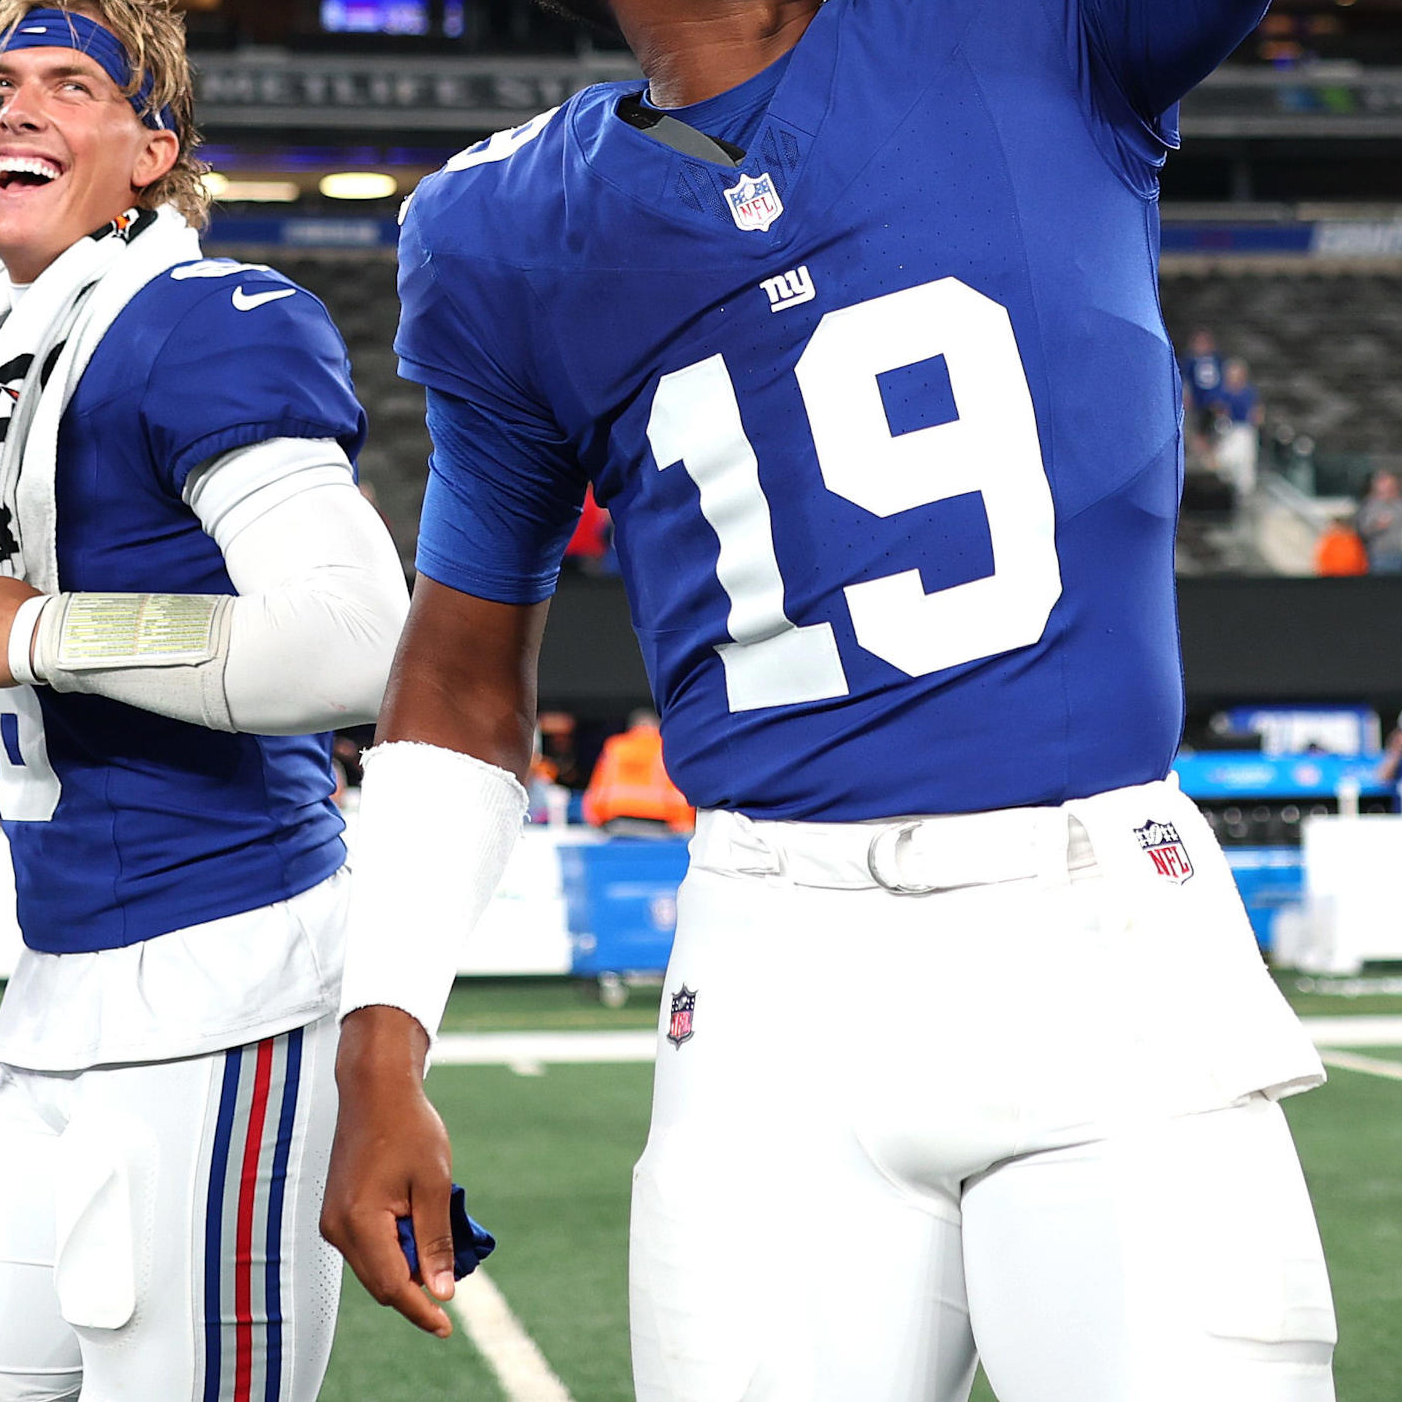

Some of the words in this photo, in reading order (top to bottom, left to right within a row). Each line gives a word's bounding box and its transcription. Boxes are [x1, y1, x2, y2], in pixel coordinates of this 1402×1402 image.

[739, 196, 775, 220] NFL
[646, 276, 1063, 713] 19
[1147, 846, 1190, 878] NFL
